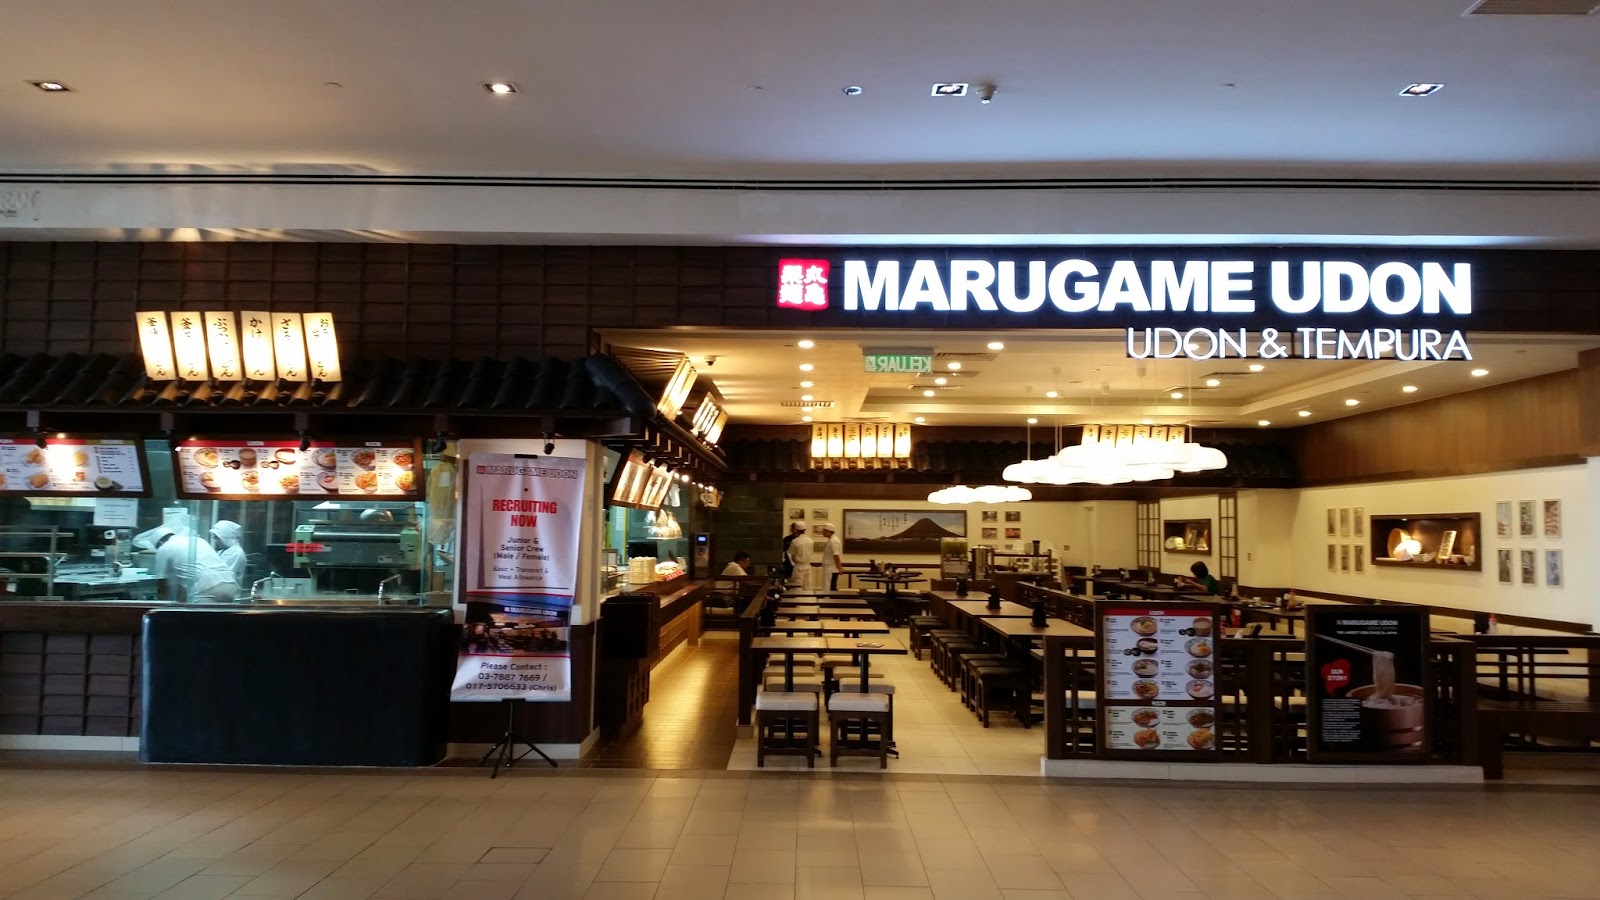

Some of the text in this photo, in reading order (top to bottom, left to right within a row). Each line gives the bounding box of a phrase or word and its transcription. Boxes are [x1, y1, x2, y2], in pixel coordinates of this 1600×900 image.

[843, 258, 1473, 315] MARUGAME UDON
[1127, 327, 1474, 362] UDON & TEMPURA
[487, 466, 578, 479] MARUGAME UDON
[492, 499, 557, 513] RECRUITING
[510, 515, 537, 527] NOW
[493, 552, 514, 560] (Male
[522, 553, 550, 561] Female)
[516, 566, 543, 574] Transport
[480, 662, 508, 671] Please
[510, 663, 542, 671] Contact
[478, 672, 516, 681] 03-7887
[465, 683, 557, 692] 017-5706633 (Chris)
